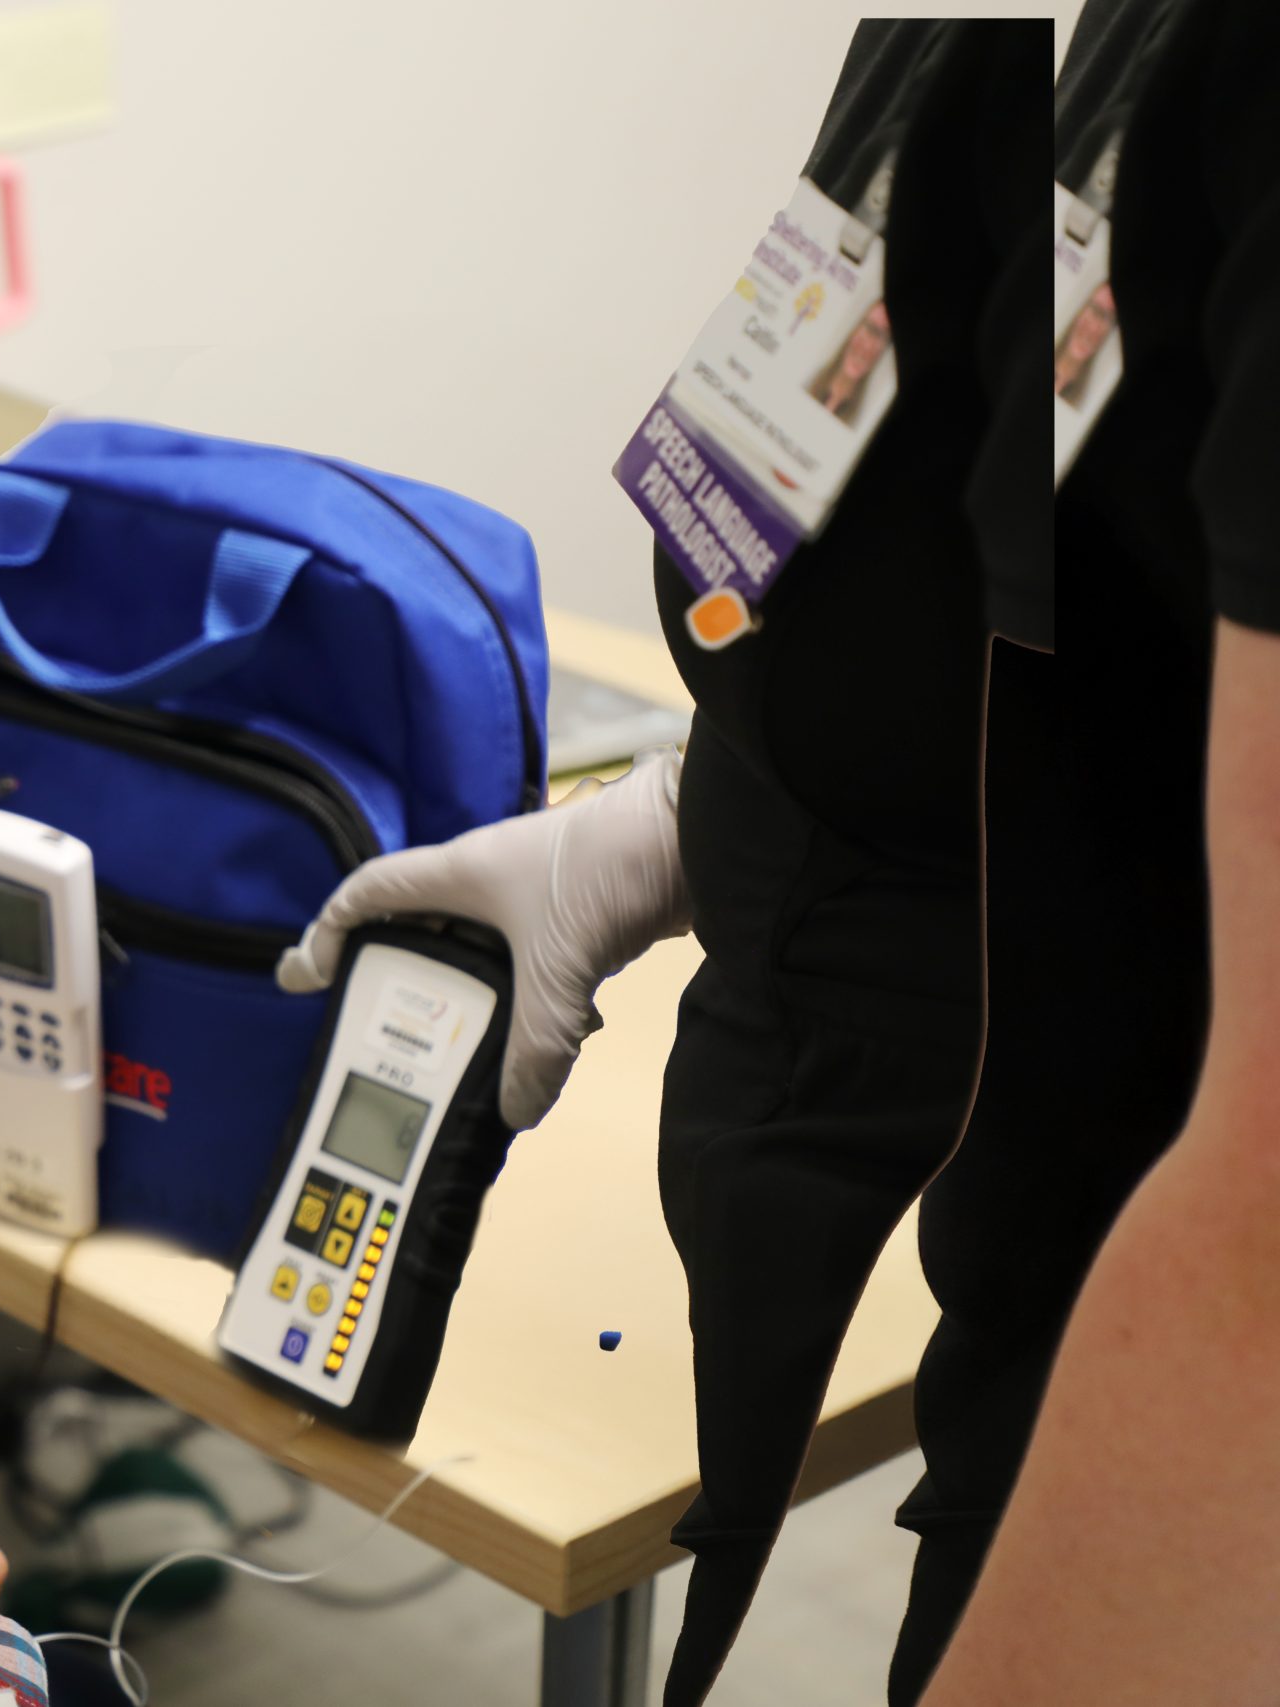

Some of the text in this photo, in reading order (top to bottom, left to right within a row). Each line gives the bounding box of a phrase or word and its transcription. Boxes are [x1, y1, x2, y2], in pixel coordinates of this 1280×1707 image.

[637, 460, 738, 588] PATHOLOGIST
[643, 407, 778, 585] SPEECH LANGUAGE
[376, 1061, 415, 1087] PRO
